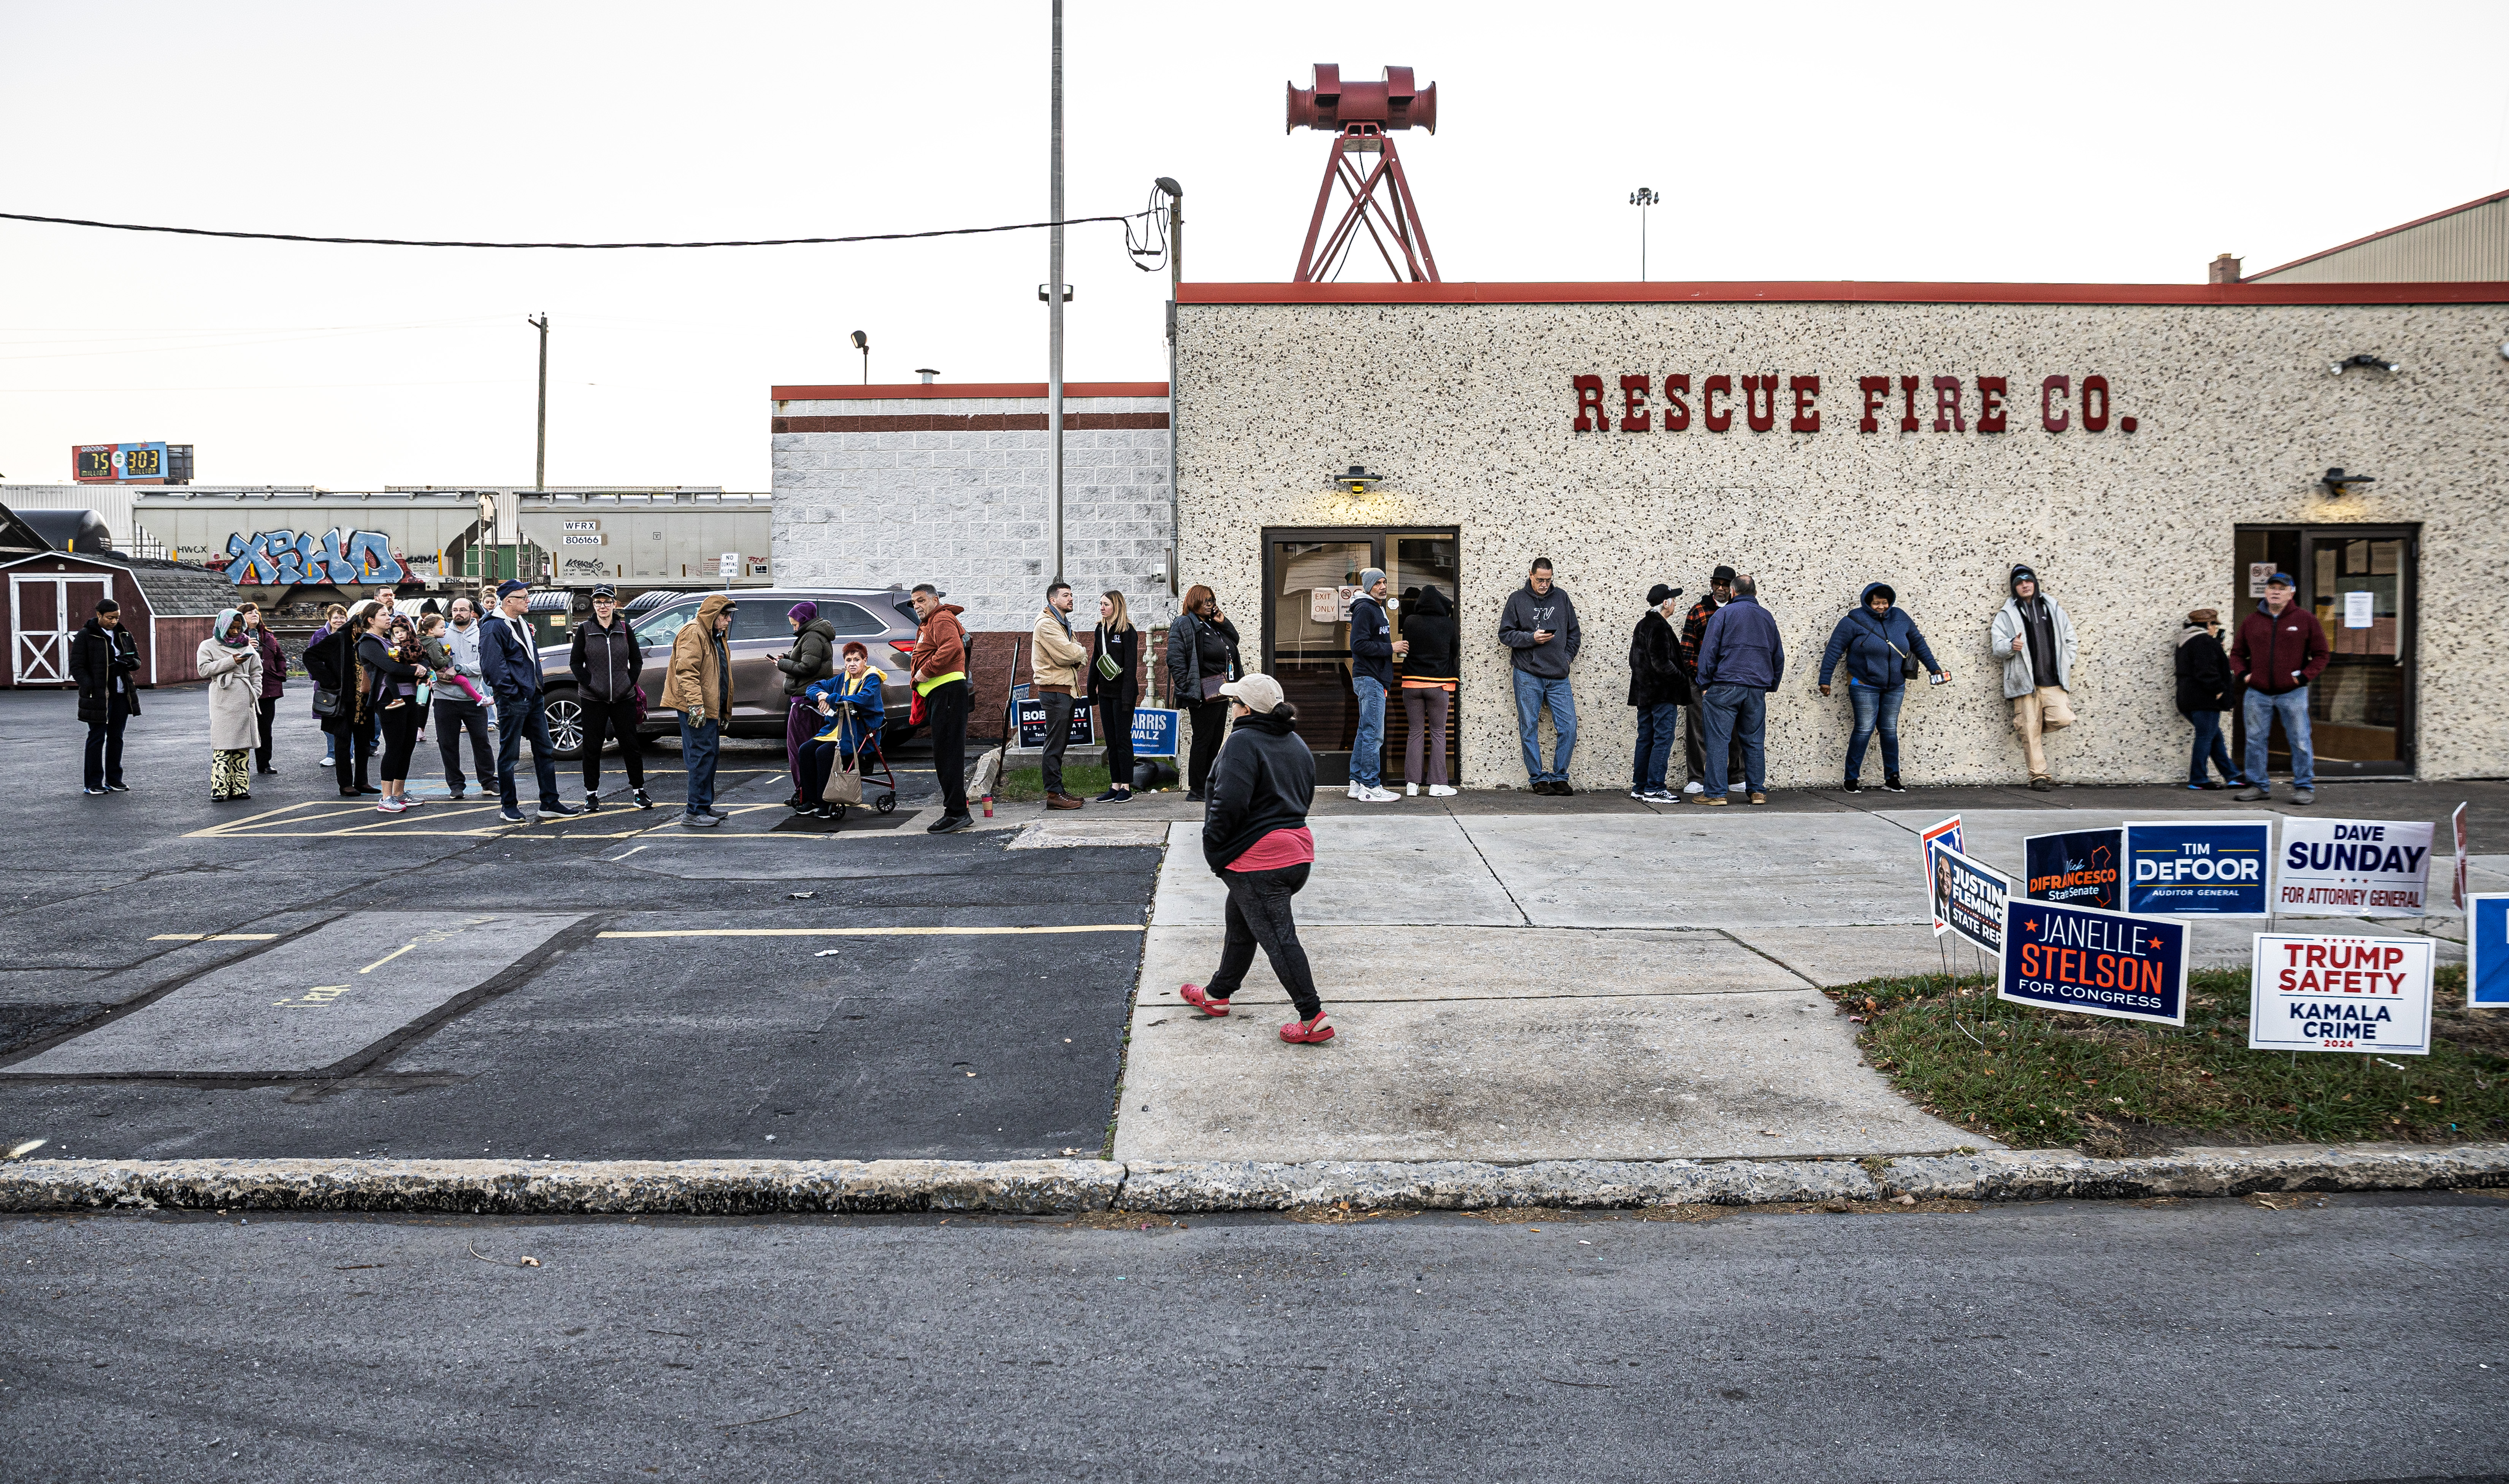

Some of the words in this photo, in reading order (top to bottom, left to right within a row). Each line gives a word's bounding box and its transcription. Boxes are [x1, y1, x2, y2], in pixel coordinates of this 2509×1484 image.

[1573, 373, 1820, 432] RESCUE
[1860, 375, 2007, 432] FIRE
[2042, 374, 2137, 432] CO.
[92, 453, 109, 469] 75
[128, 451, 158, 469] 303
[1023, 710, 1046, 721] BOB
[1131, 713, 1167, 730] ARRIS
[2334, 824, 2385, 841] DAVE
[2182, 843, 2210, 855] TIM
[2286, 841, 2428, 873] SUNDAY
[1953, 865, 2003, 907] JUSTIN
[2030, 869, 2116, 893] DIFRANCESCO
[2069, 886, 2099, 897] Senate
[1952, 884, 2003, 924] FLEMING
[2281, 886, 2304, 903] FOR
[2307, 888, 2368, 906] ATTORNEY
[2369, 889, 2422, 908] GENERAL
[1953, 907, 1980, 934] STATE
[2039, 913, 2147, 956] JANELLE
[2021, 943, 2163, 994] STELSON
[2284, 944, 2404, 970] TRUMP
[2019, 979, 2054, 994] FOR
[2060, 985, 2162, 1008] CONGRESS
[2278, 969, 2408, 994] SAFETY
[2290, 1002, 2392, 1022] KAMALA
[2303, 1021, 2377, 1039] CRIME
